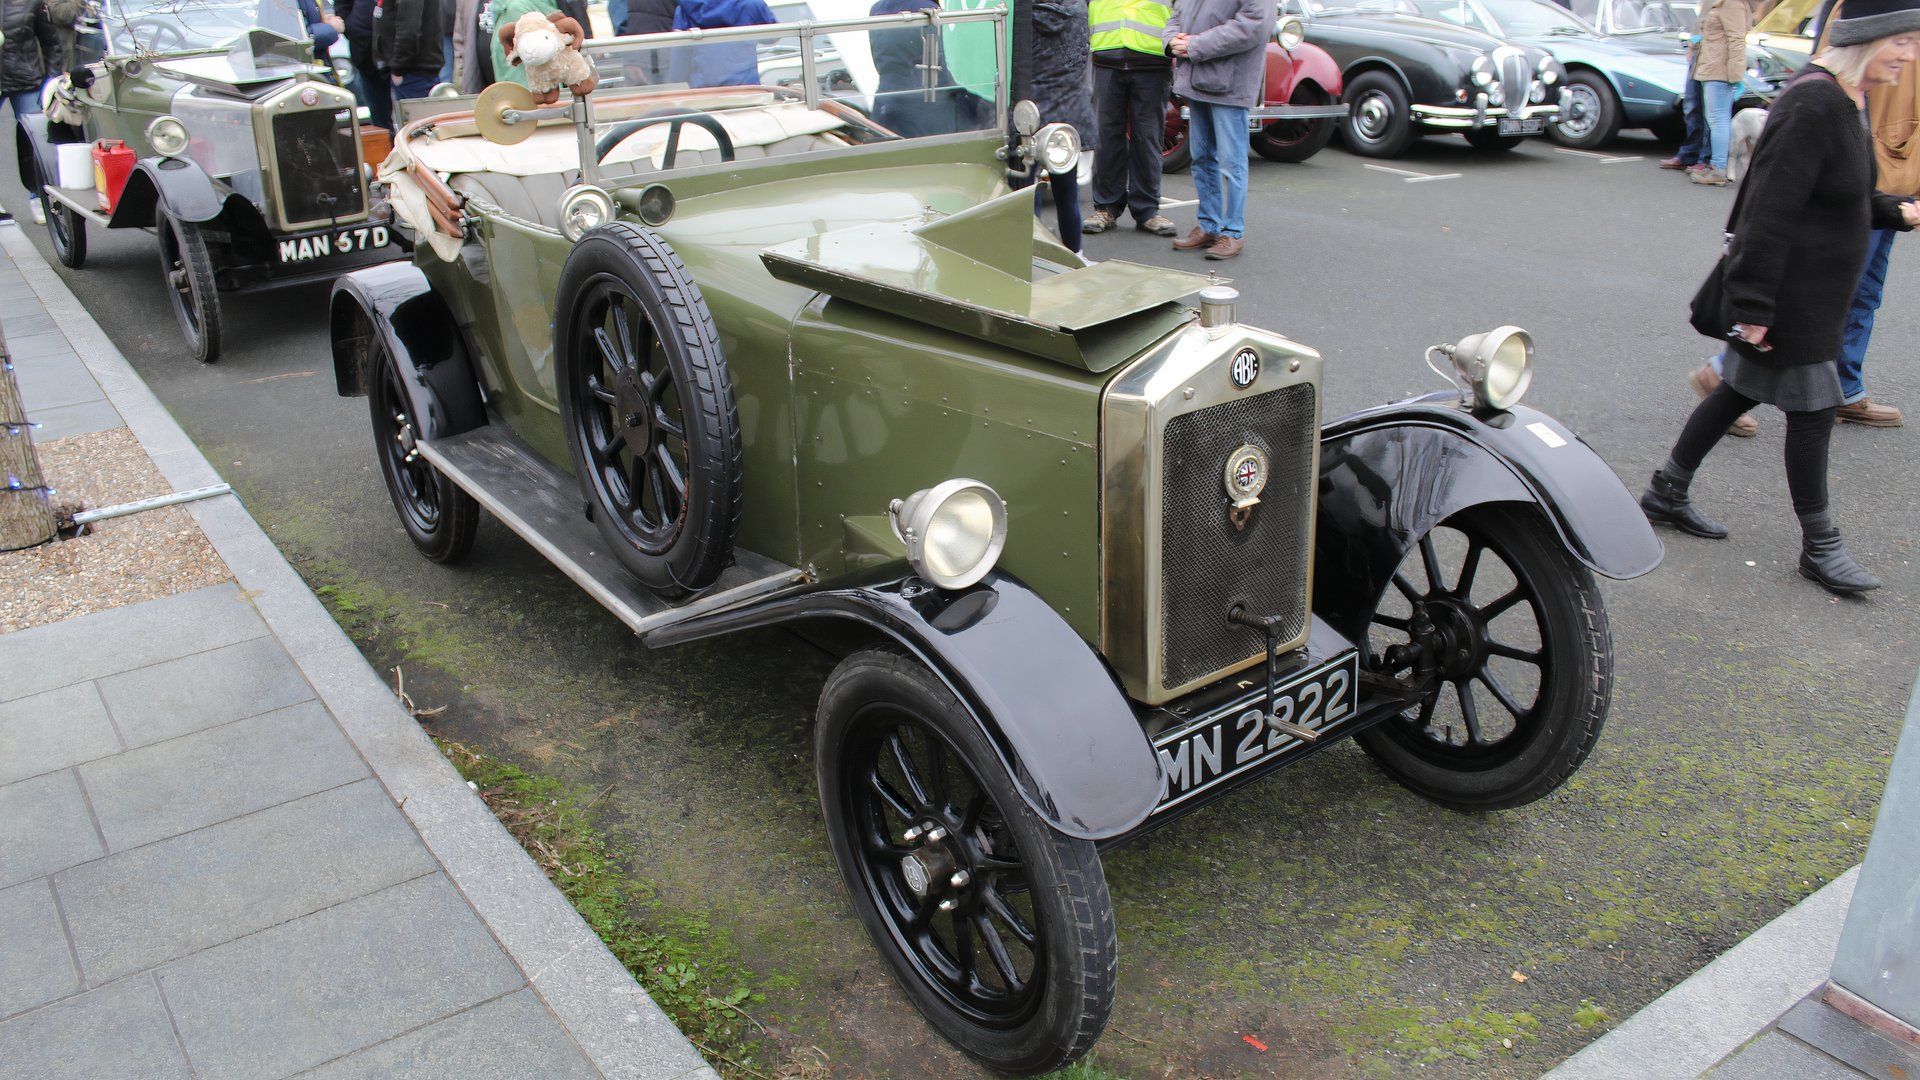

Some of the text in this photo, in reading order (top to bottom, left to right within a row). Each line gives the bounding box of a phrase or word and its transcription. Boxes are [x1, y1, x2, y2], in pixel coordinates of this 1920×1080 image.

[279, 226, 390, 263] MAN 67D
[1159, 668, 1350, 801] MN 2222
